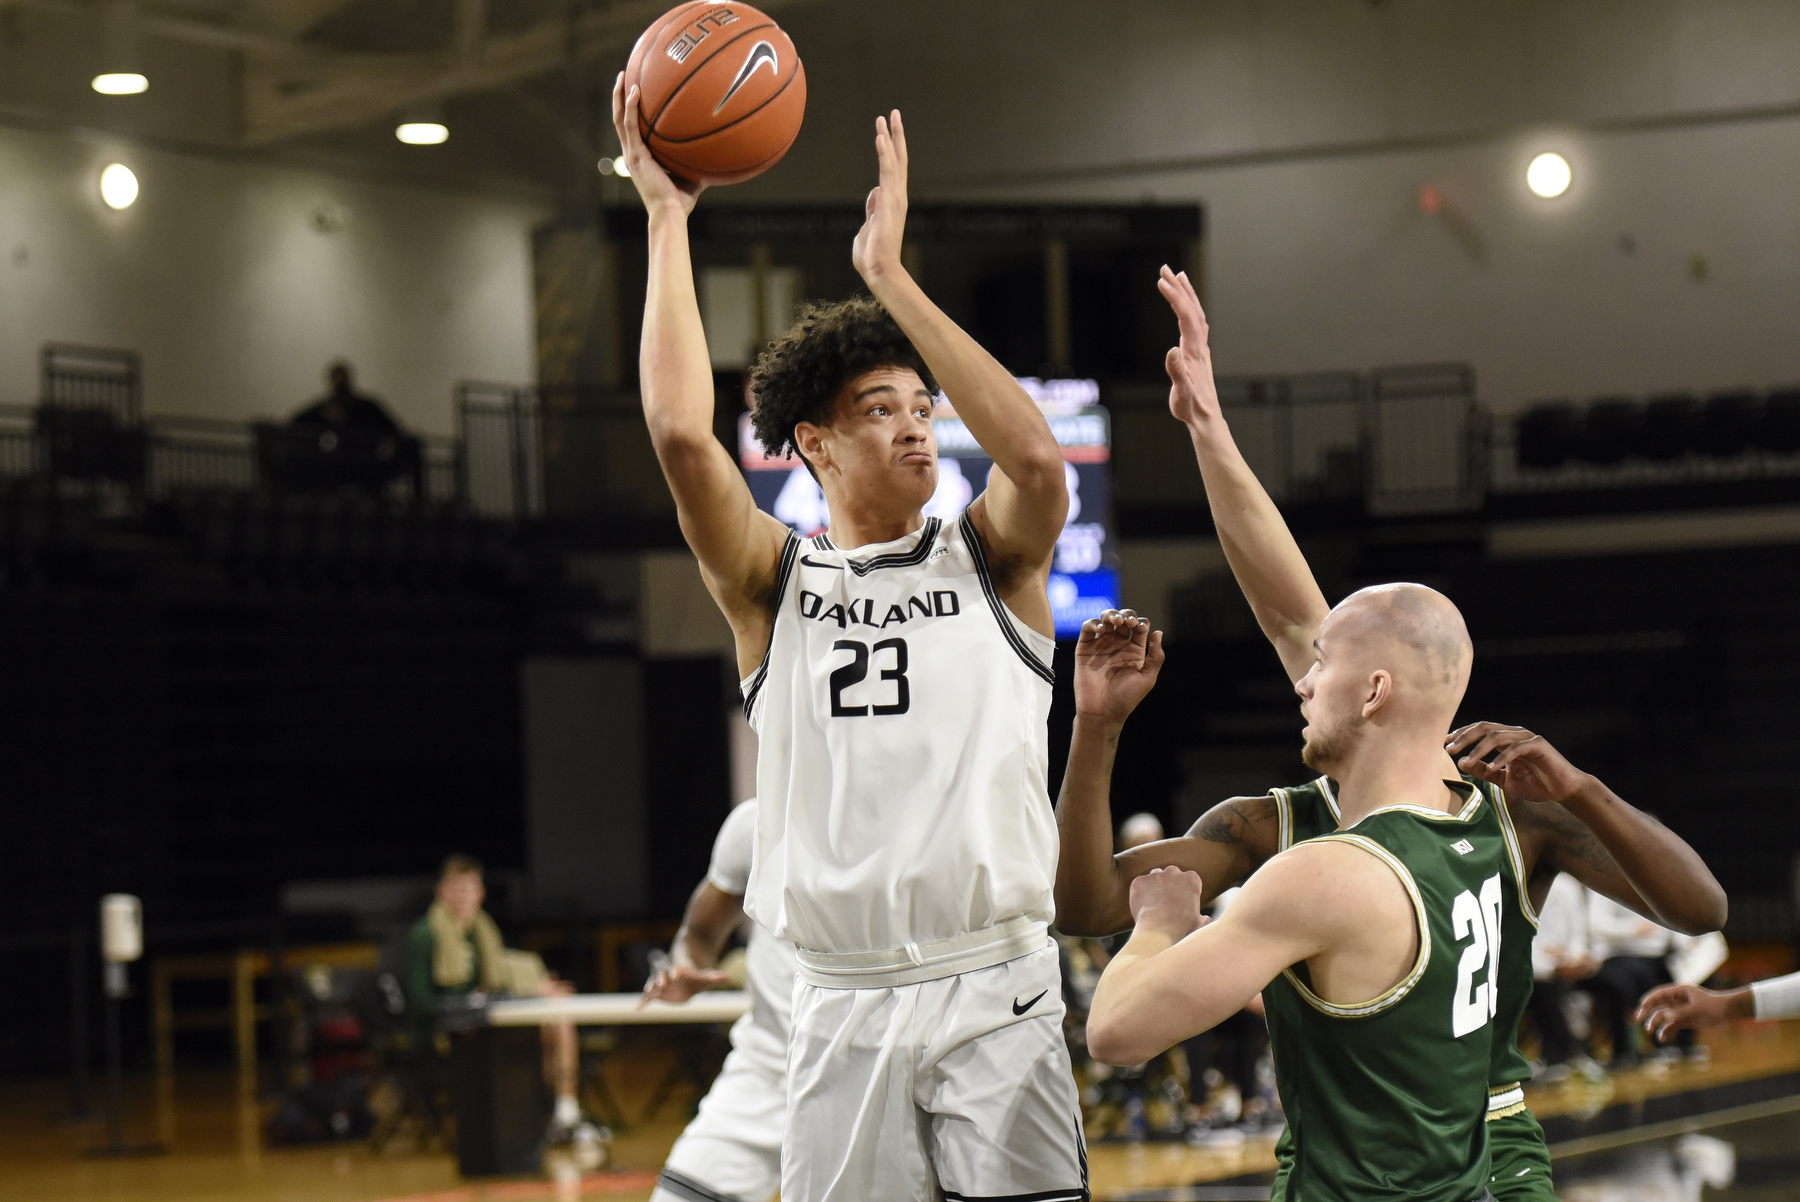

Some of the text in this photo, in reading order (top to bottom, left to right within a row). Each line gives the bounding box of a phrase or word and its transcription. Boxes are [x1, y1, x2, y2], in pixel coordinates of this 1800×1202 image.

[665, 8, 740, 64] ELITE
[800, 590, 960, 629] OAKLAND
[829, 637, 910, 717] 23
[1451, 871, 1503, 1038] 20
